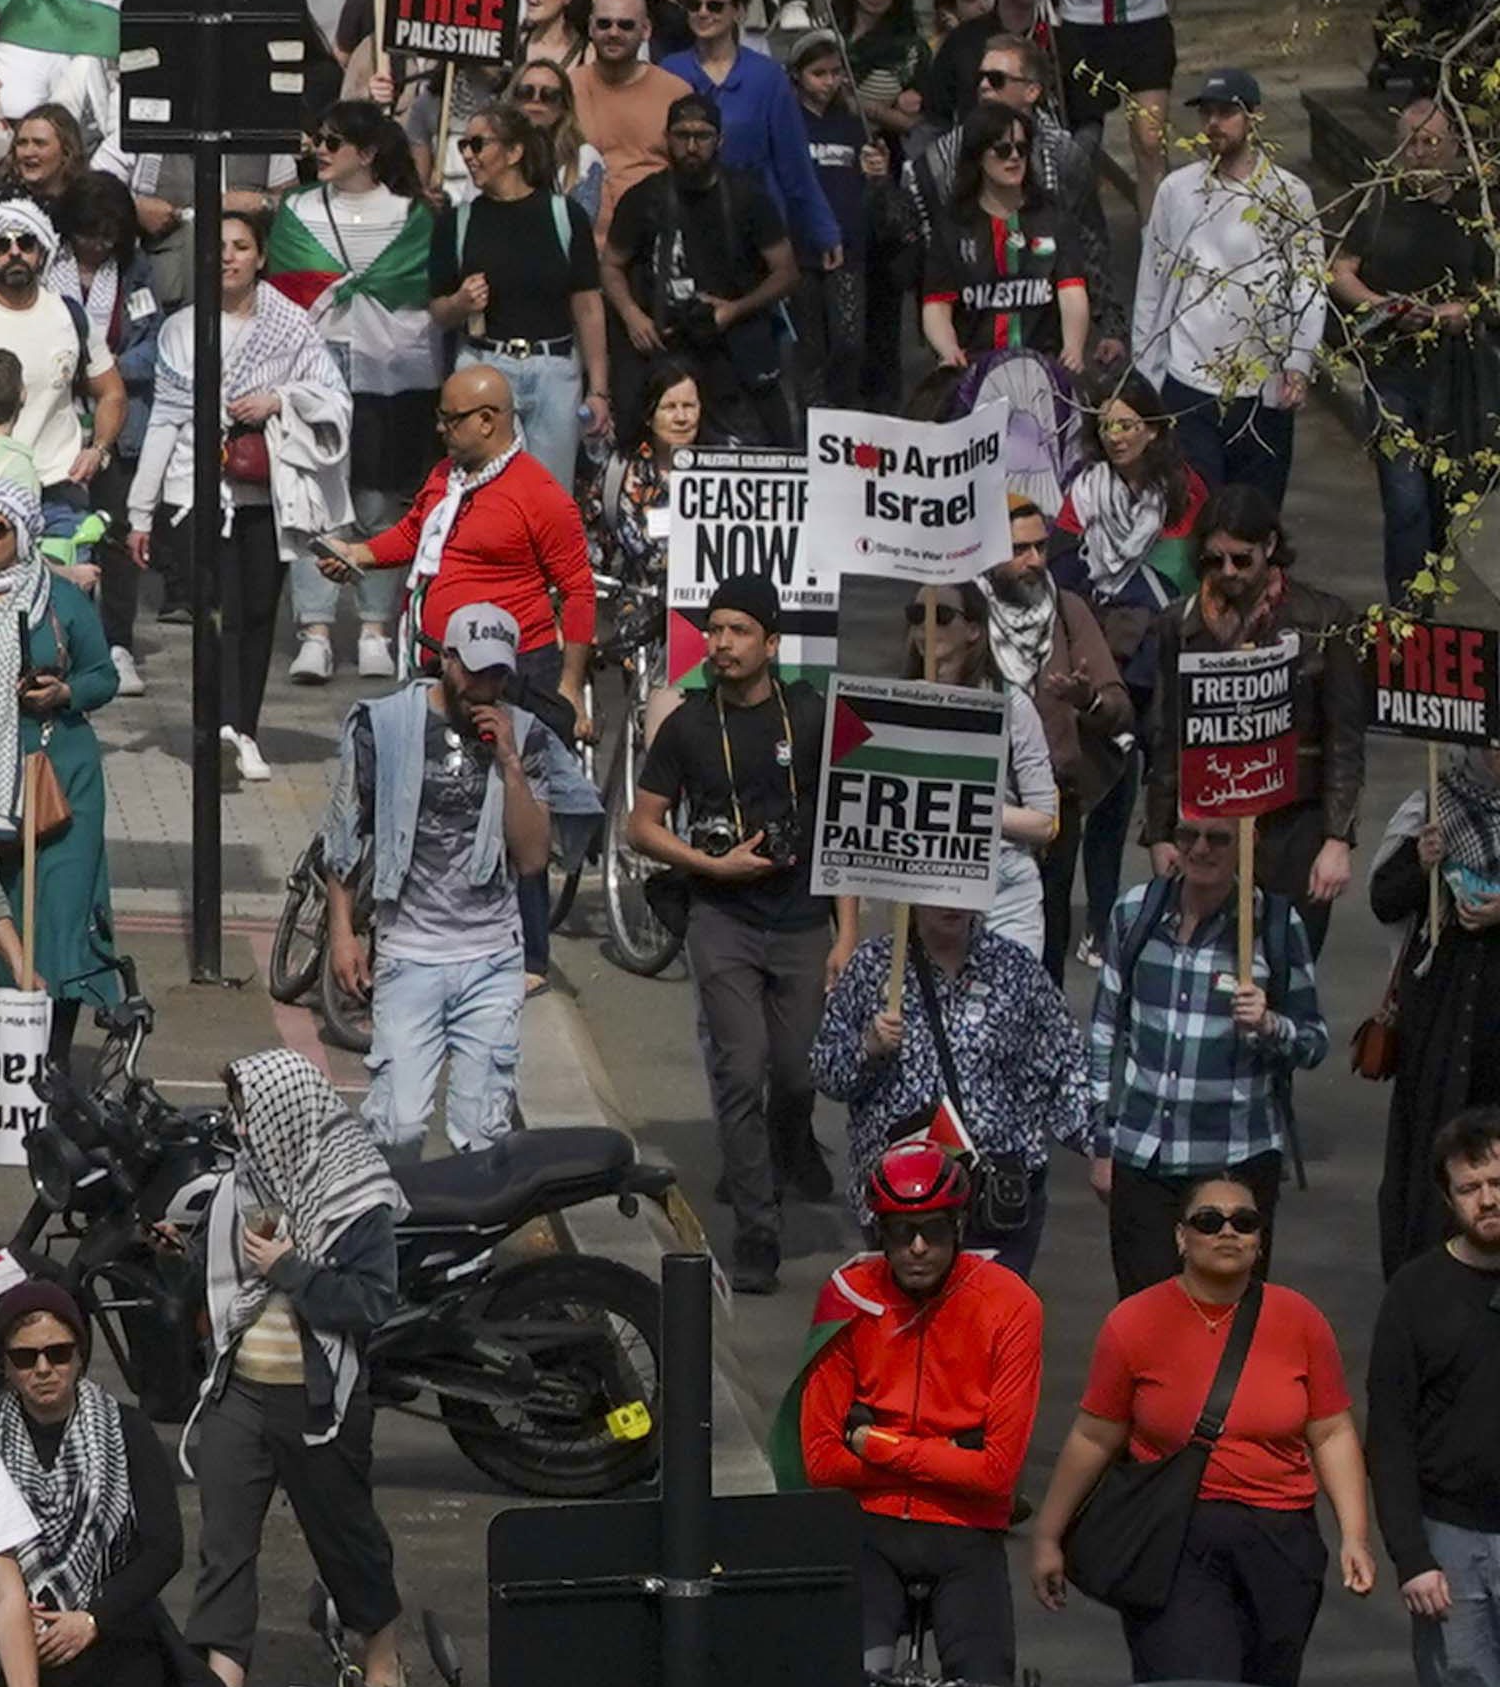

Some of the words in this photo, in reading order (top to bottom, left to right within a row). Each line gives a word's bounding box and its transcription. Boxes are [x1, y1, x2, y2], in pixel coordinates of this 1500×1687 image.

[395, 18, 502, 60] PALESTINE
[819, 433, 898, 477] Stp
[902, 430, 1002, 480] Arming
[863, 479, 977, 528] Israel
[1191, 666, 1290, 705] FREEDOM
[1236, 701, 1253, 715] for
[1186, 700, 1293, 745] PALESTINE
[1377, 688, 1485, 735] PALESTINE
[824, 771, 998, 836] FREE
[821, 824, 992, 863] PALESTINE
